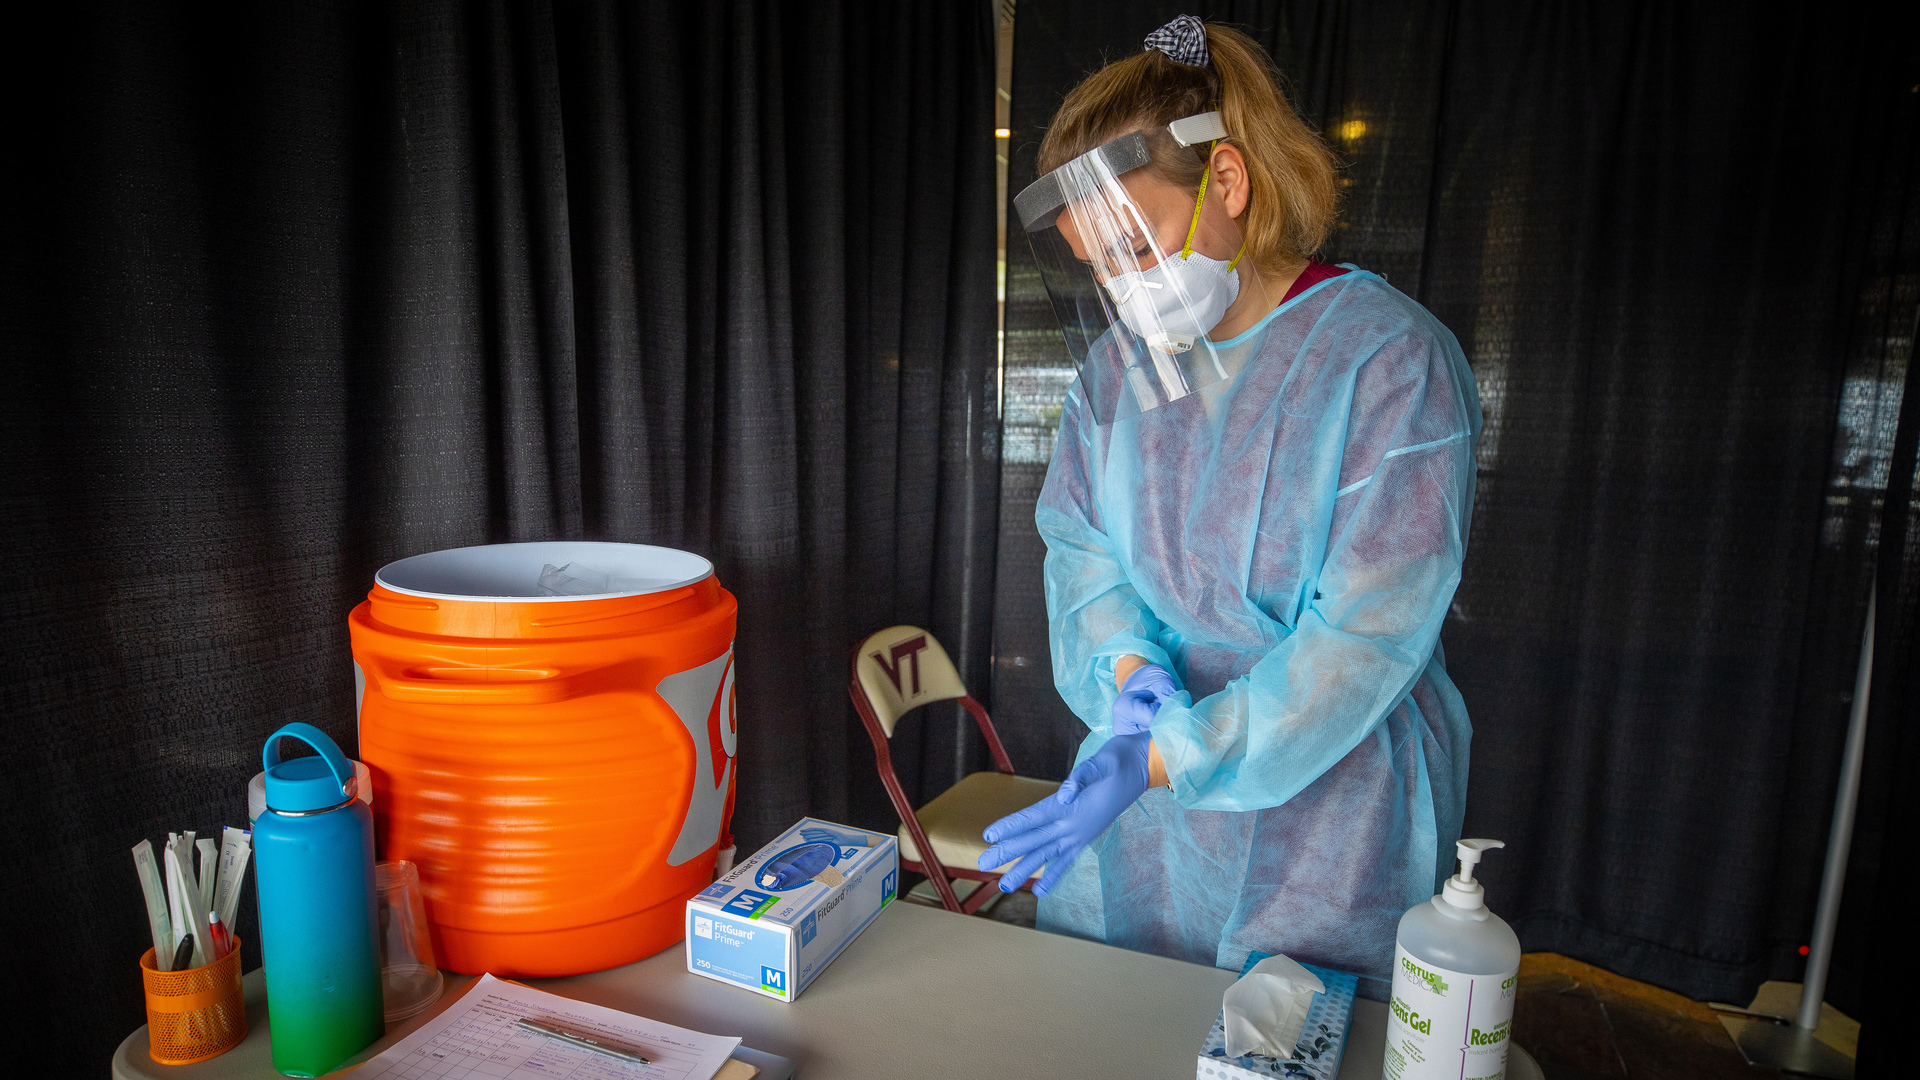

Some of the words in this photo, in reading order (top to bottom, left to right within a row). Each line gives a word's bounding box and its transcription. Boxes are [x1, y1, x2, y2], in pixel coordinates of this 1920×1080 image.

[870, 634, 927, 700] VT
[884, 873, 894, 897] M
[730, 894, 764, 911] M
[780, 907, 794, 917] 250
[696, 958, 711, 969] 250
[1402, 957, 1435, 983] CERTUS
[766, 969, 781, 988] M
[1400, 967, 1447, 998] MEDICAL
[1410, 1012, 1432, 1036] Gel
